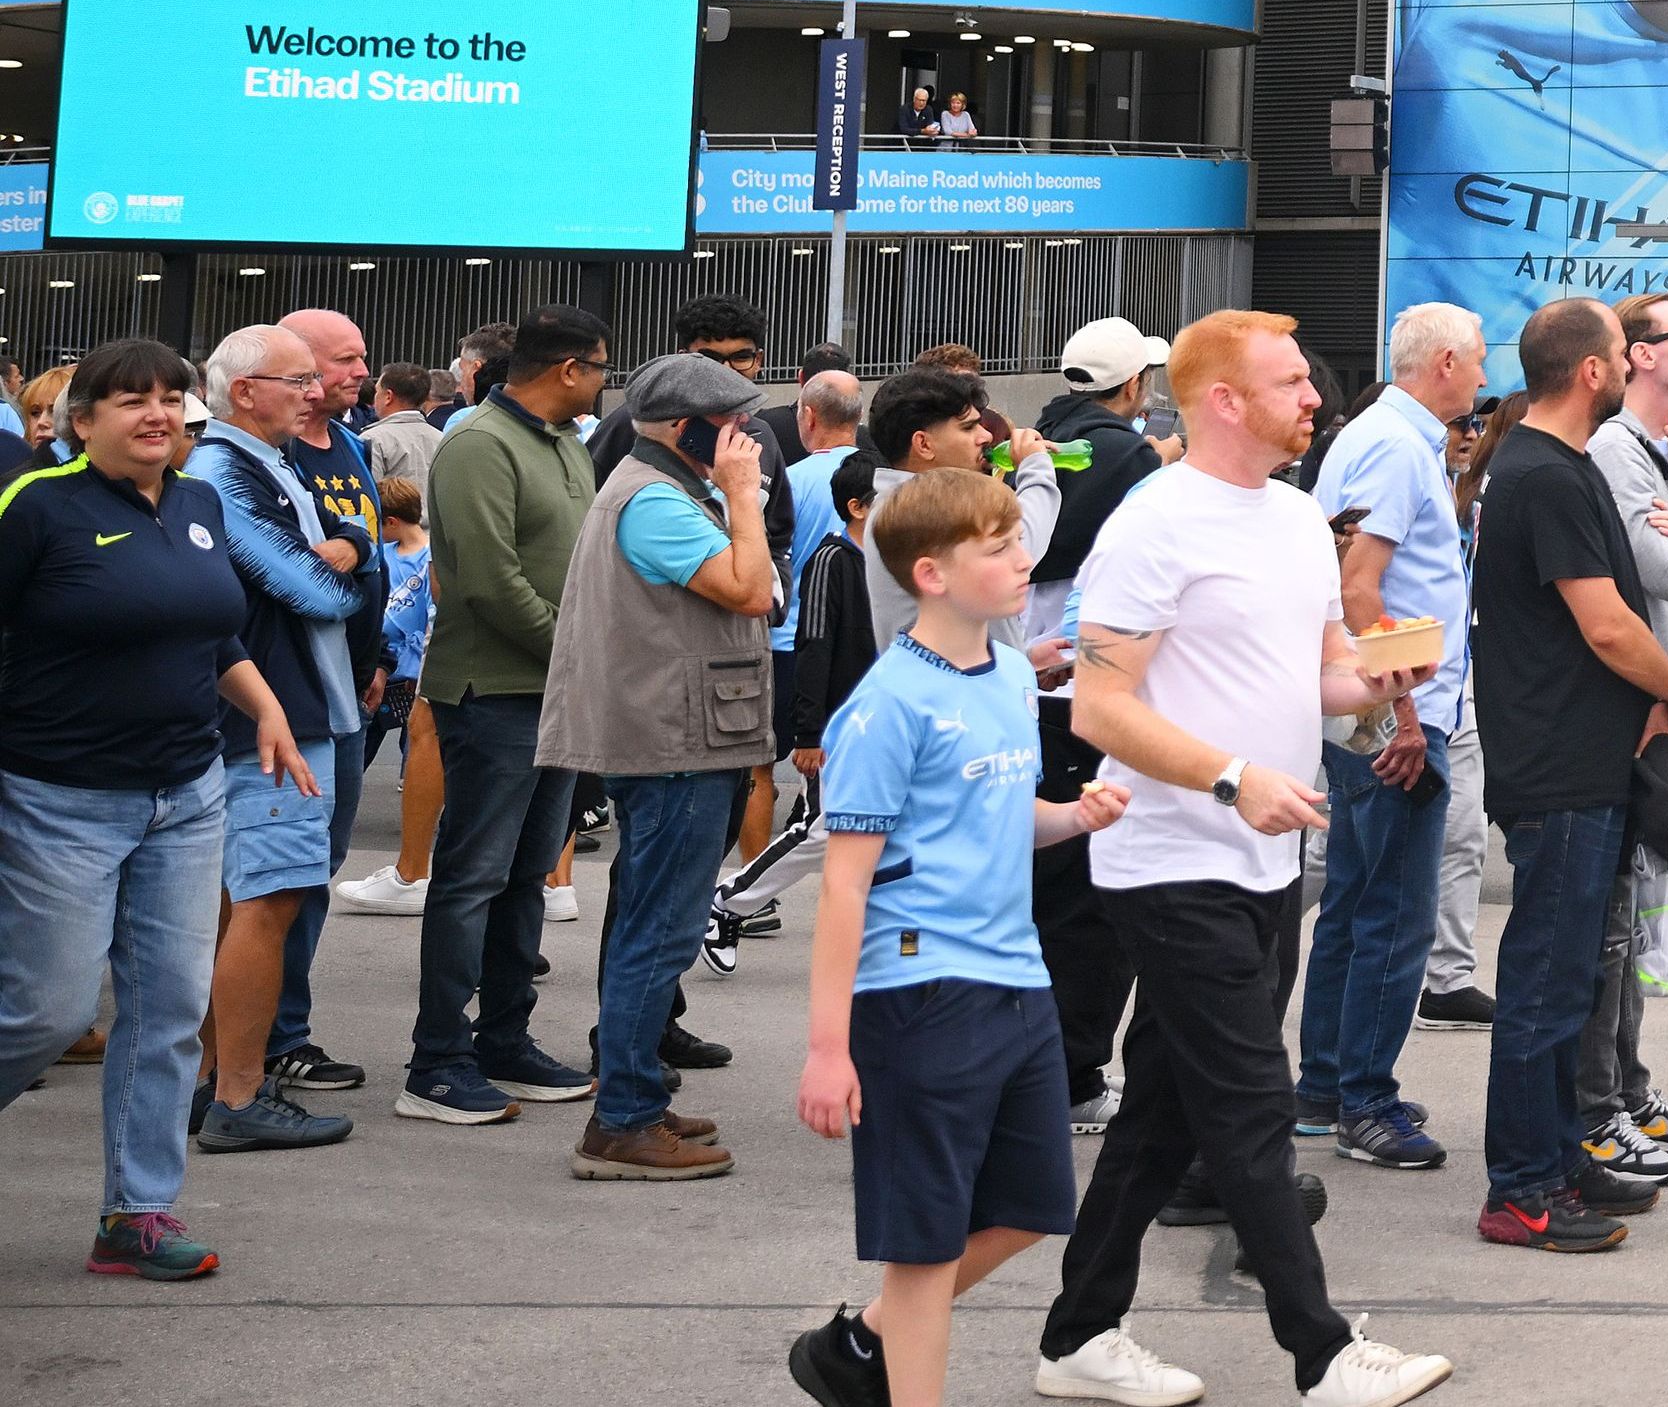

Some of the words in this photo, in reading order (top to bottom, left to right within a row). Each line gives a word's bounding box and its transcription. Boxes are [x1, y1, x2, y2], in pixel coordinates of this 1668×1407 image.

[246, 24, 415, 59] Welcome
[424, 32, 460, 60] to
[468, 32, 526, 62] the
[244, 66, 359, 101] Etihad
[367, 69, 520, 104] Stadium
[834, 53, 848, 100] WEST
[829, 104, 846, 197] RECEPTION
